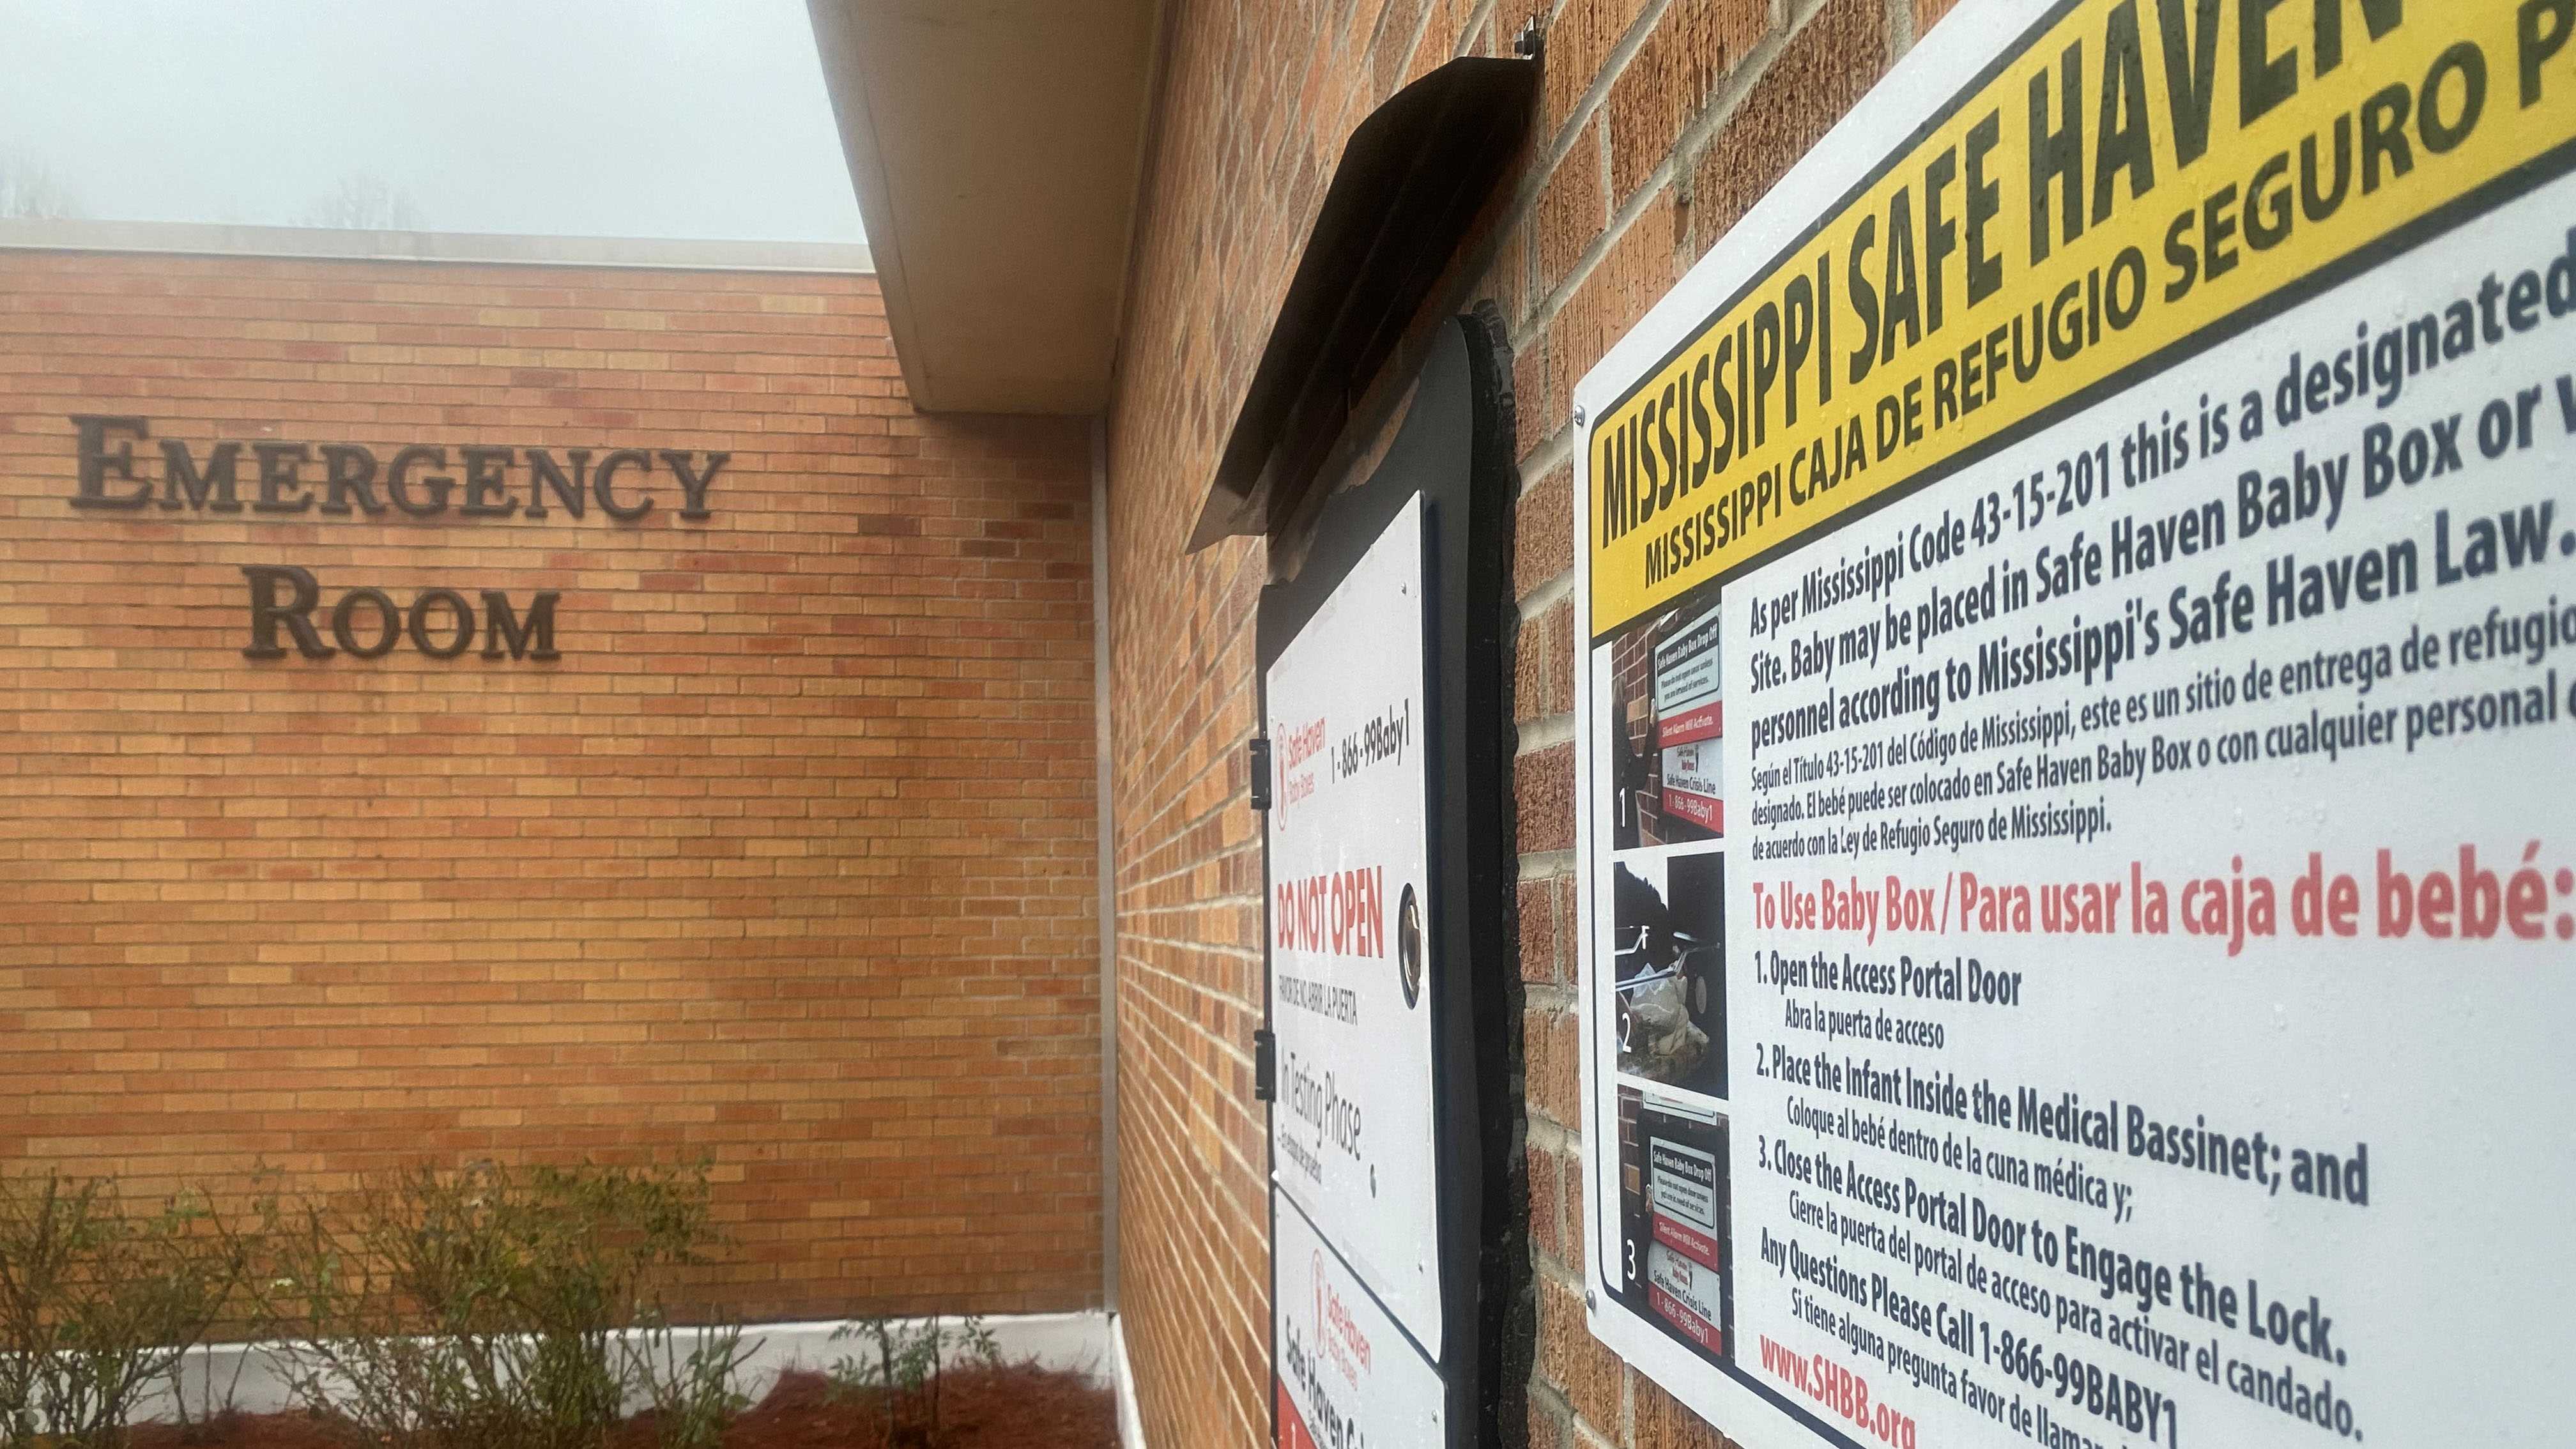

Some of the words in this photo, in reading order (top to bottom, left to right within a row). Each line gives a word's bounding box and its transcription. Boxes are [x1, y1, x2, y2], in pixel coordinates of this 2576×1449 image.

[1600, 253, 1830, 548] MISSISSIPPI
[1849, 109, 2002, 384] SAFE
[2030, 0, 2401, 266] HAVE
[1646, 464, 1780, 588] MISSISSIPPI
[1790, 415, 1866, 505] CAJA
[1876, 377, 1922, 461] DE
[1935, 247, 2145, 430] REFUGIO
[2165, 42, 2487, 302] SEGURO
[69, 414, 730, 519] EMERGENCY
[1751, 597, 1767, 638] As
[1771, 589, 1798, 640] per
[1802, 531, 1903, 617] Mississippi
[1910, 510, 1965, 572] Code
[1971, 442, 2109, 547] 43-15-201
[2121, 411, 2189, 488] this
[2200, 393, 2229, 459] is
[2239, 390, 2263, 442] a
[2276, 226, 2576, 427] designated
[1751, 650, 1786, 693] Site.
[1791, 631, 1834, 682] Baby
[1839, 620, 1880, 669] may
[1886, 604, 1911, 650] be
[1917, 565, 1995, 654] placed
[2003, 559, 2028, 613] in
[2036, 532, 2101, 602] Safe
[2112, 499, 2225, 579] Haven
[2238, 450, 2349, 539] Baby
[2364, 413, 2463, 499] Box
[2478, 384, 2542, 459] or
[241, 564, 561, 659] ROOM
[1752, 687, 1834, 760] personnel
[1839, 664, 1940, 728] according
[1945, 658, 1971, 702] to
[1979, 598, 2159, 696] Mississippi's
[2169, 571, 2254, 649] Safe
[2267, 539, 2418, 626] Haven
[2435, 500, 2576, 586] Law.
[1752, 763, 1780, 796] Según
[1794, 753, 1823, 783] Título
[1827, 741, 1883, 777] 43-15-201
[1910, 728, 1956, 766] Código
[1982, 700, 2076, 749] Mississippi,
[2081, 696, 2120, 732] este
[2186, 668, 2236, 713] sitio
[2280, 644, 2392, 695] entrega
[2449, 596, 2576, 666] refugio
[1752, 795, 1804, 831] designado.
[1818, 786, 1845, 817] bebé
[1848, 781, 1885, 820] puede
[1910, 767, 1970, 805] colocado
[1997, 757, 2032, 793] Safe
[2037, 754, 2092, 788] Haven
[2097, 740, 2146, 786] Baby
[2152, 735, 2191, 774] Box
[2265, 702, 2398, 762] cualquier
[2406, 670, 2557, 753] personal
[1619, 788, 1625, 827] 1
[1703, 778, 1716, 795] Line
[1766, 831, 1805, 859] acuerdo
[1841, 826, 1859, 860] Ley
[1881, 817, 1930, 855] Refugio
[1934, 815, 1984, 853] Seguro
[2011, 795, 2112, 844] Mississippi.
[1278, 880, 1294, 949] DO
[1298, 875, 1327, 953] NOT
[1331, 865, 1384, 958] OPEN
[1754, 883, 1775, 929] To
[1781, 881, 1816, 930] Use
[1822, 877, 1879, 946] Baby
[1887, 876, 1935, 931] Box
[1961, 872, 2031, 932] Para
[2041, 883, 2120, 933] usar
[2131, 861, 2168, 934] la
[2182, 855, 2275, 957] caja
[2292, 852, 2359, 937] de
[2377, 840, 2575, 940] bebé:
[1622, 1013, 1631, 1053] 2
[1755, 951, 1767, 984] 1.
[1770, 950, 1807, 995] Open
[1811, 951, 1838, 990] the
[1843, 953, 1896, 995] Access
[1900, 956, 1961, 1001] Portal
[1968, 959, 2021, 1006] Door
[1785, 999, 1811, 1030] Abra
[1828, 1010, 1871, 1041] puerta
[1896, 1019, 1944, 1049] acceso
[1325, 1070, 1361, 1161] Phase
[1757, 1043, 1769, 1077] 2.
[1773, 1045, 1811, 1085] Place
[1814, 1052, 1841, 1092] the
[1846, 1057, 1901, 1106] Infant
[1906, 1067, 1967, 1119] Inside
[1972, 1079, 2011, 1129] the
[2018, 1086, 2118, 1152] Medical
[2127, 1105, 2281, 1196] Bassinet;
[2291, 1142, 2369, 1207] and
[1788, 1096, 1834, 1139] Coloque
[1852, 1110, 1885, 1149] bebé
[1889, 1119, 1938, 1163] dentro
[1986, 1152, 2028, 1188] cuna
[2034, 1158, 2108, 1209] médica
[1627, 1239, 1636, 1281] 3
[1759, 1135, 1771, 1170] 3.
[1774, 1139, 1811, 1184] Close
[1815, 1152, 1842, 1194] the
[1846, 1160, 1900, 1213] Access
[1905, 1177, 1966, 1237] Portal
[1973, 1197, 2026, 1256] Door
[2031, 1220, 2058, 1267] to
[2066, 1225, 2172, 1312] Engage
[2179, 1262, 2237, 1329] the
[2248, 1279, 2347, 1367] Lock.
[1698, 1298, 1712, 1321] Line
[1761, 1227, 1786, 1278] Any
[1790, 1239, 1867, 1307] Questions
[1872, 1273, 1931, 1337] Please
[1936, 1302, 1974, 1357] Call
[1980, 1322, 2177, 1449] 1-866-99BABY1
[1790, 1190, 1823, 1229] Cierre
[1841, 1215, 1885, 1254] puerta
[1889, 1225, 1910, 1264] del
[1915, 1243, 1962, 1284] portal
[1991, 1271, 2050, 1318] acceso
[2056, 1295, 2102, 1339] para
[2108, 1315, 2189, 1372] activar
[2227, 1360, 2363, 1443] candado.
[1804, 1295, 1836, 1336] tiene
[1839, 1312, 1884, 1361] alguna
[1888, 1341, 1957, 1399] pregunta
[1961, 1369, 2005, 1419] favor
[1761, 1335, 1915, 1449] www.SHBB.org
